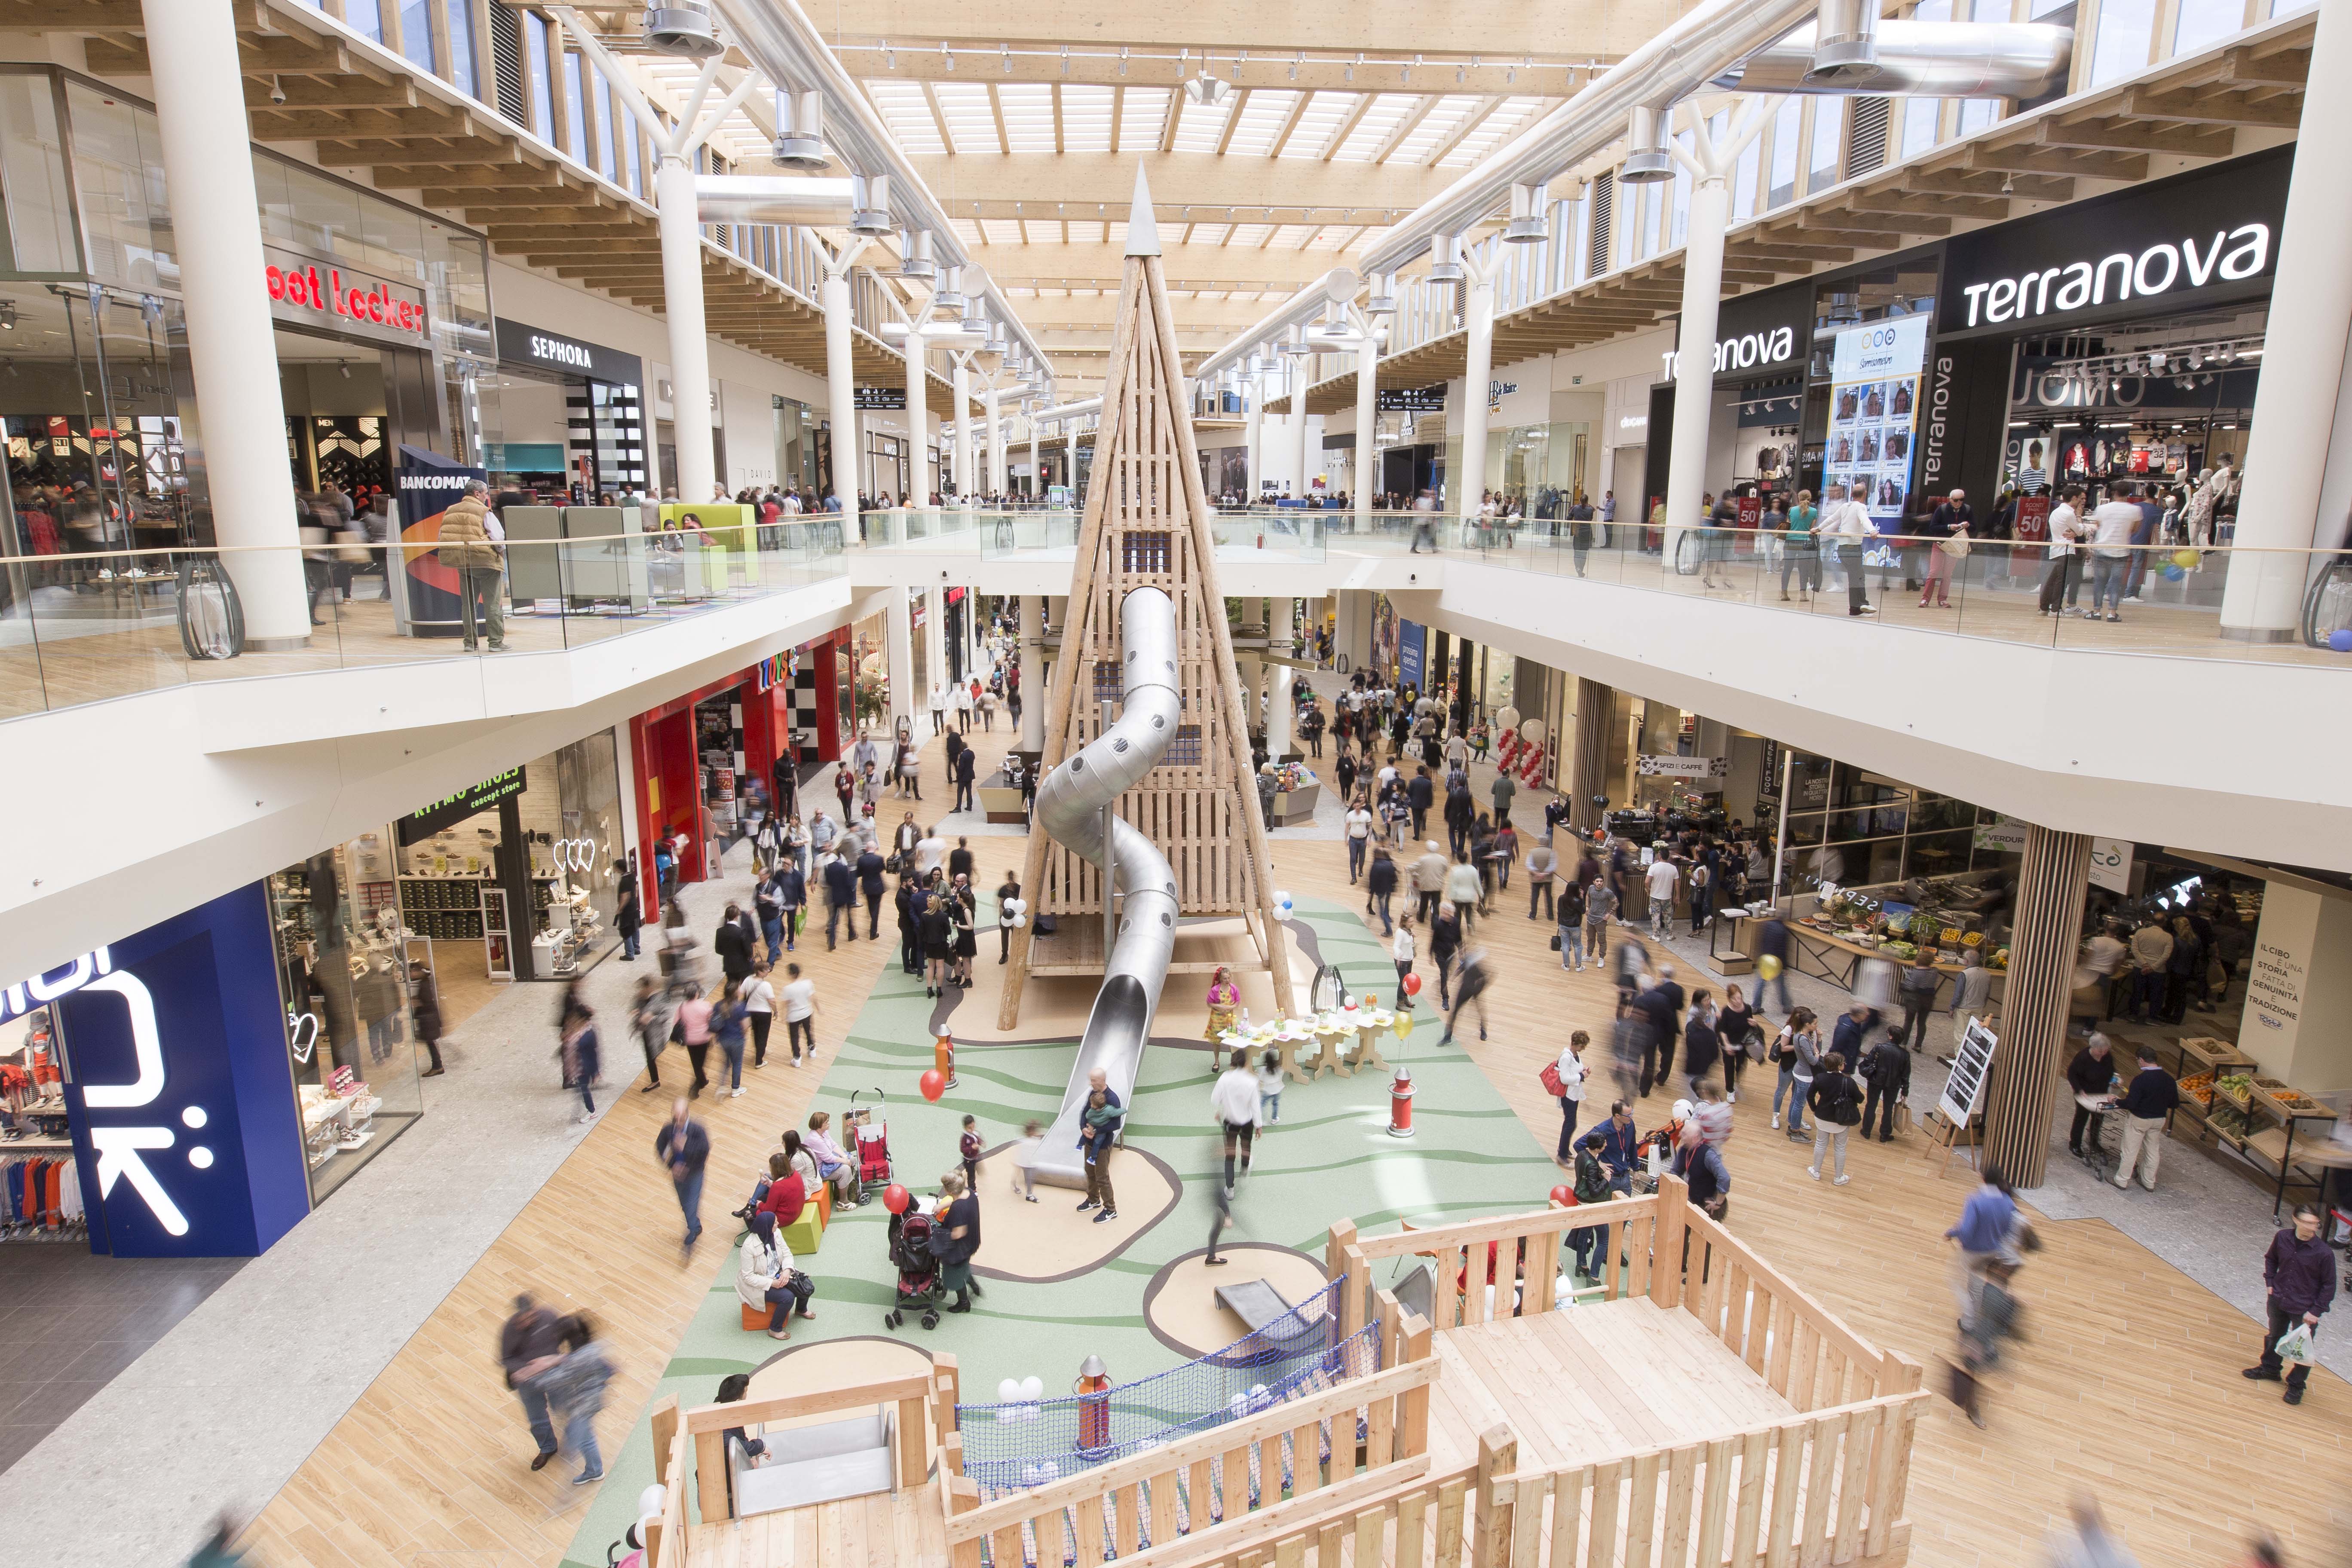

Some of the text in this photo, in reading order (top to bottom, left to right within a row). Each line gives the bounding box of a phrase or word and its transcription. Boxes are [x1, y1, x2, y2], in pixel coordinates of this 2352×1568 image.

[1964, 223, 2269, 327] Terranova
[265, 264, 424, 333] oot Locker
[531, 336, 592, 368] SEPHORA
[1662, 327, 1792, 381] Tanova
[1924, 357, 1952, 485] Terranova
[1401, 426, 1413, 437] adidas
[885, 443, 897, 456] MANGO
[751, 469, 771, 478] DAVID
[2001, 439, 2020, 494] OMO
[401, 476, 471, 489] BANCOMAT
[1403, 646, 1418, 658] prossima
[1403, 655, 1417, 668] apertura
[761, 650, 788, 690] TOYS
[471, 781, 520, 808] concept store
[1988, 835, 2024, 844] VERDUR
[2261, 943, 2290, 959] IL CIBO
[2258, 961, 2288, 977] STORIA
[2277, 958, 2303, 974] È UNA
[2262, 973, 2285, 987] FATTA
[2253, 980, 2298, 1002] GENUINITÀ
[2249, 995, 2297, 1020] TRADIZIONE
